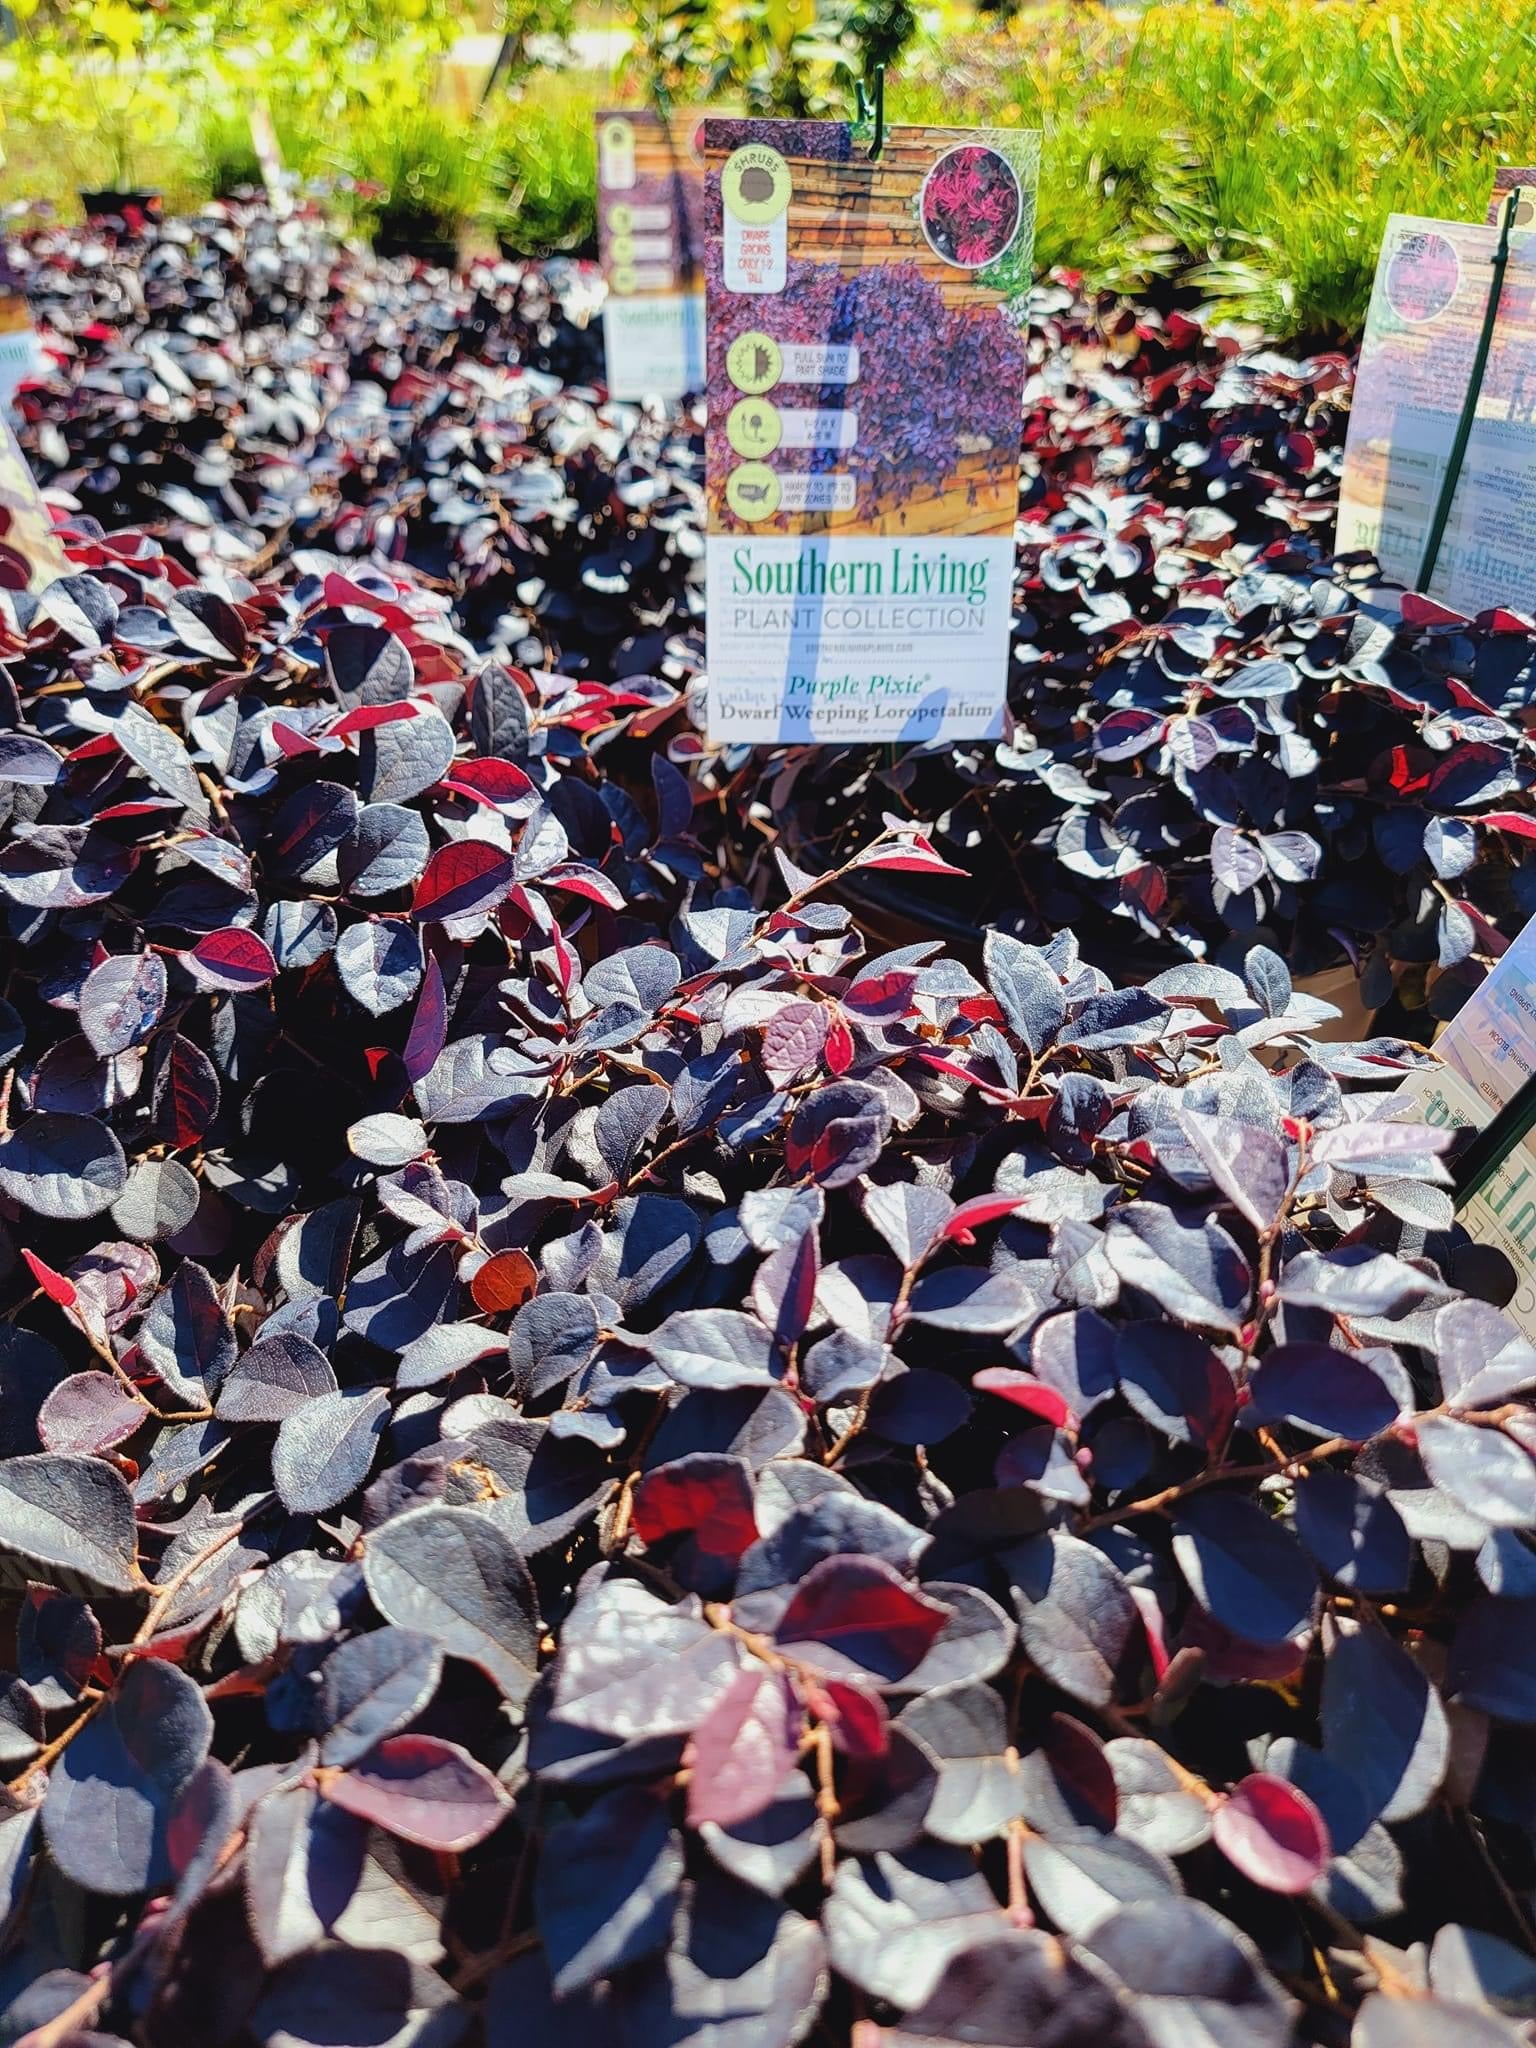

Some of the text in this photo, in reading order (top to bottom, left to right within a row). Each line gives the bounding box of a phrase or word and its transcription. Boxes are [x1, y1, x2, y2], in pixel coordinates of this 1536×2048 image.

[734, 153, 780, 173] SHRUBS
[741, 244, 771, 255] GROWS
[747, 272, 763, 283] TALL
[794, 352, 848, 364] FULL SUN TO
[796, 364, 847, 376] PART SHADE
[733, 546, 989, 606] Southern Living
[734, 608, 985, 630] PLANT COLLECTION
[788, 674, 859, 701] Purple
[720, 701, 993, 724] Dwarf Weeping Loropetalum
[1510, 988, 1532, 1013] SPRING
[1489, 1029, 1531, 1073] SPRING BLOOM
[1422, 1087, 1436, 1104] RICH
[1479, 1080, 1500, 1102] WATER
[1501, 1237, 1524, 1268] GROWTH
[1513, 1234, 1528, 1256] RATE
